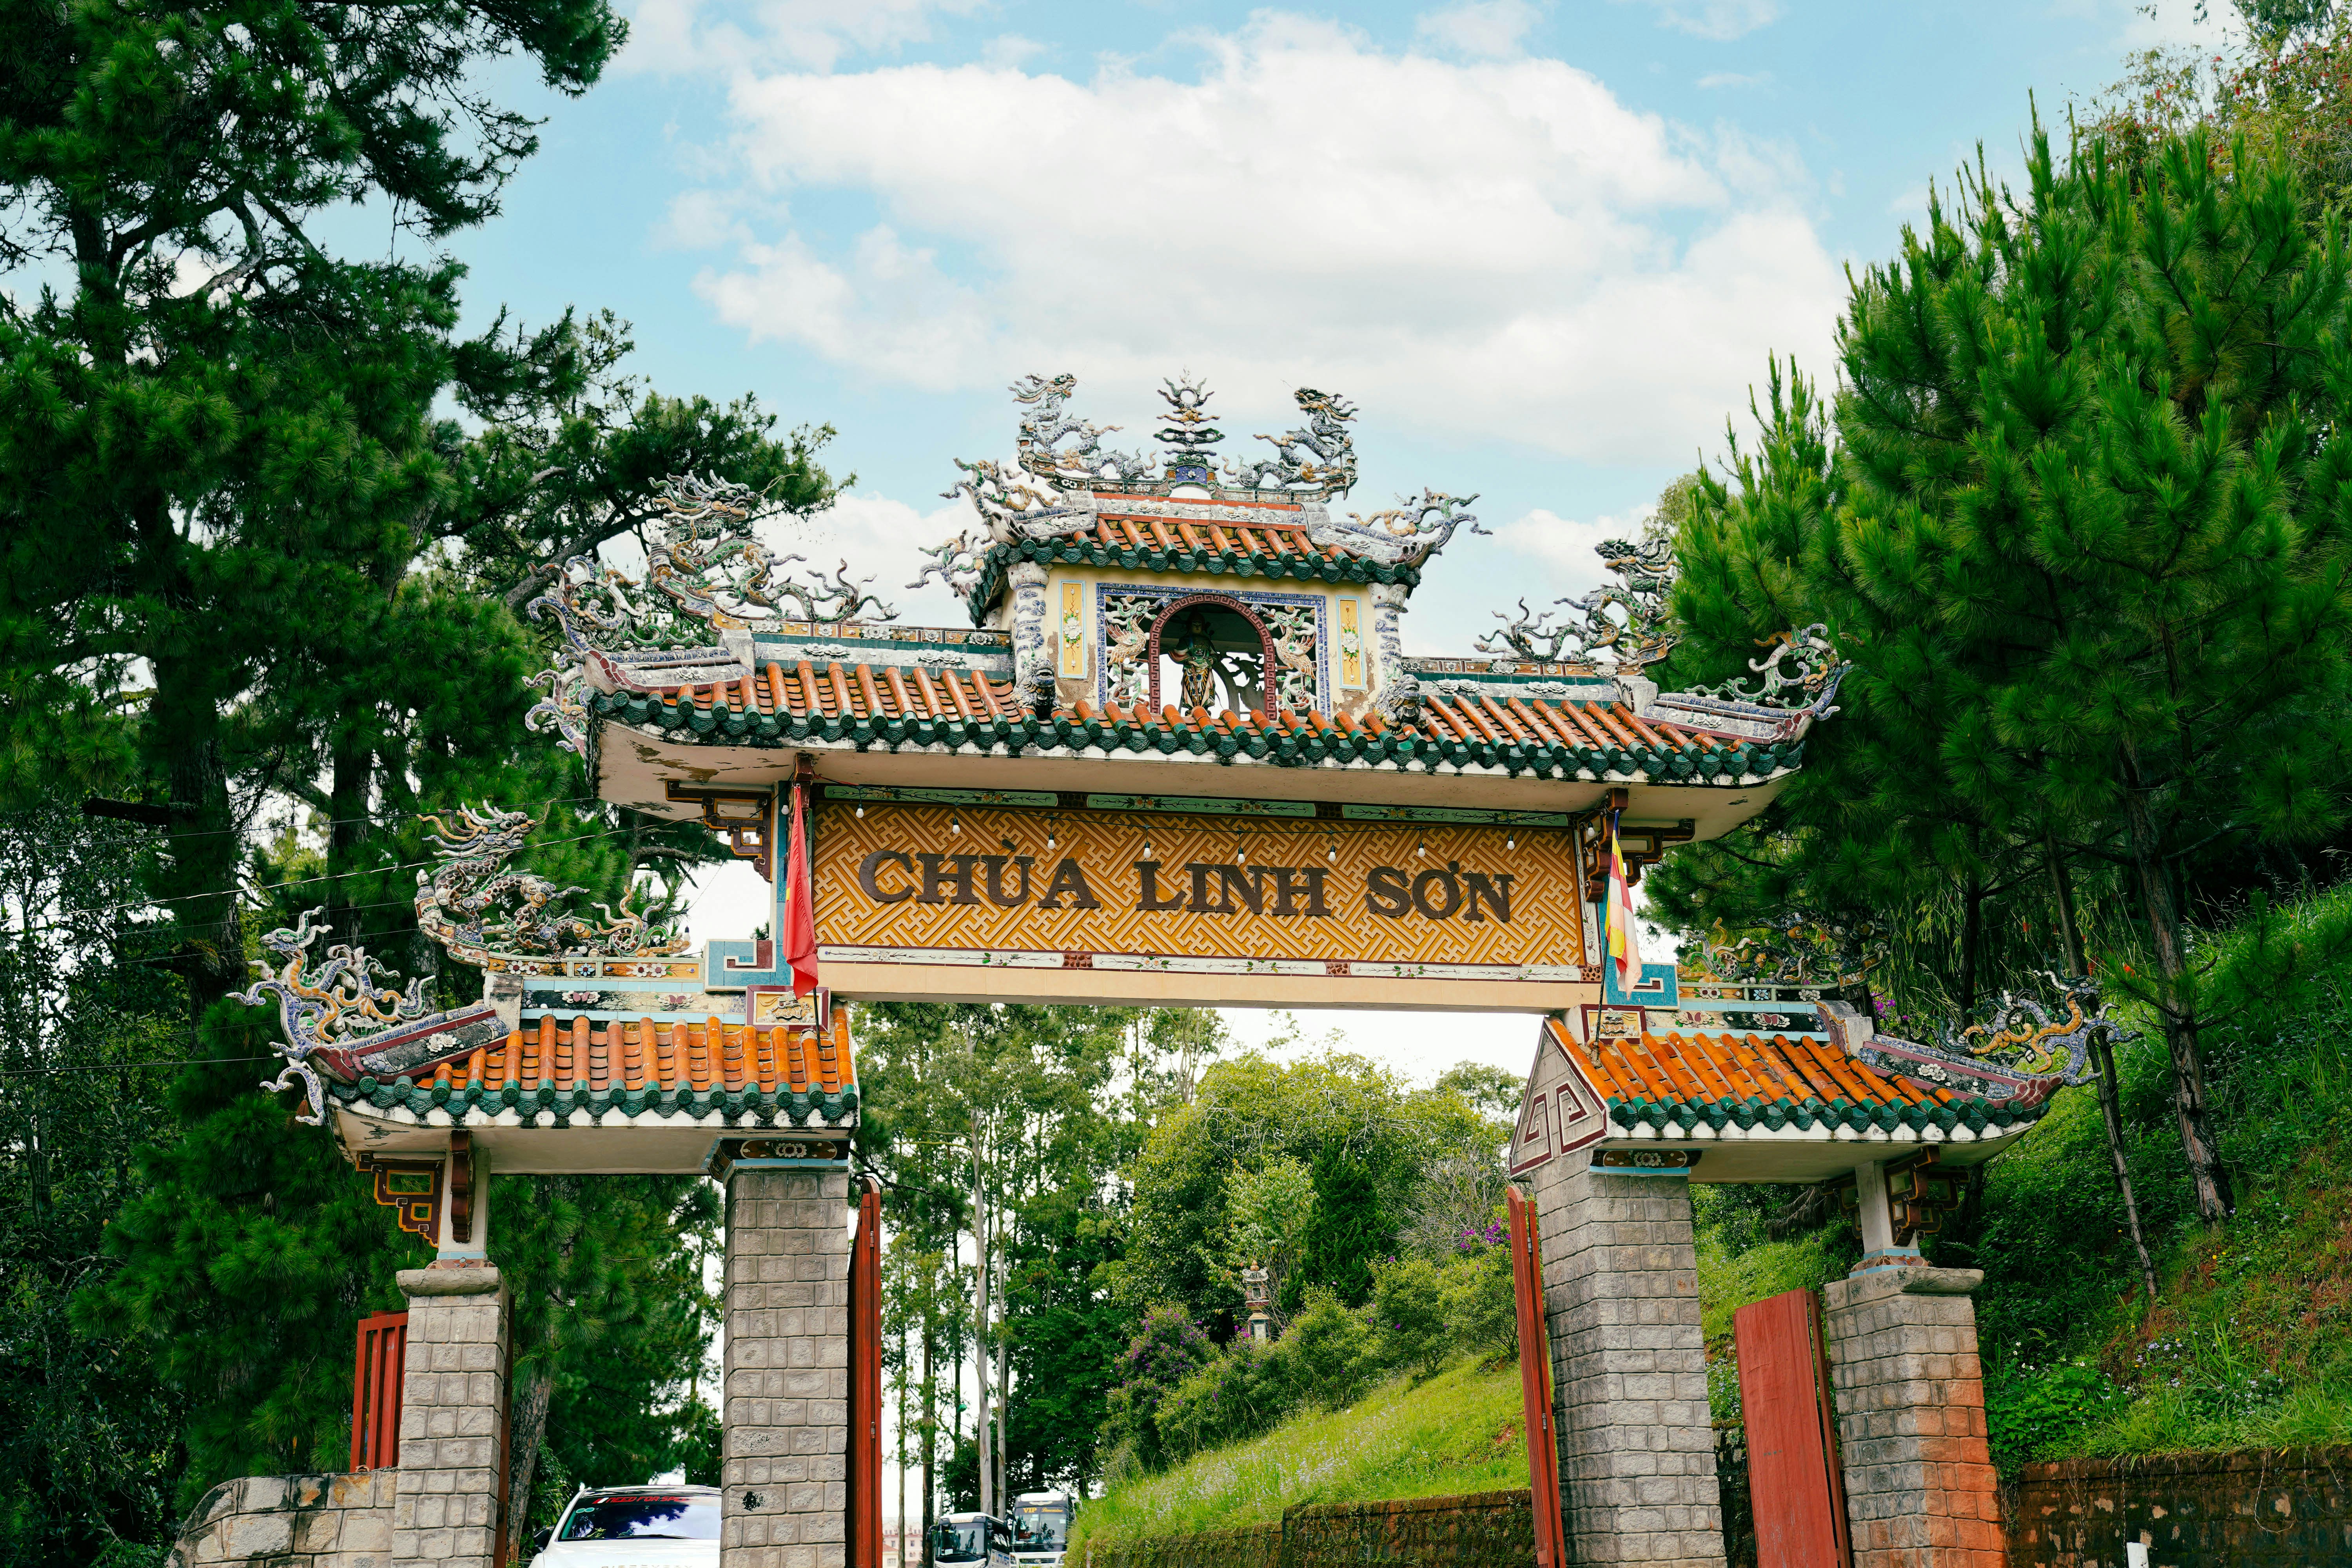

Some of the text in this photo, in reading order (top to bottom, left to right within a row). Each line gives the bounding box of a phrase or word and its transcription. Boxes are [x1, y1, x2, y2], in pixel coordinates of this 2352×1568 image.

[858, 838, 1514, 922] CHÙA LINH SƠN
